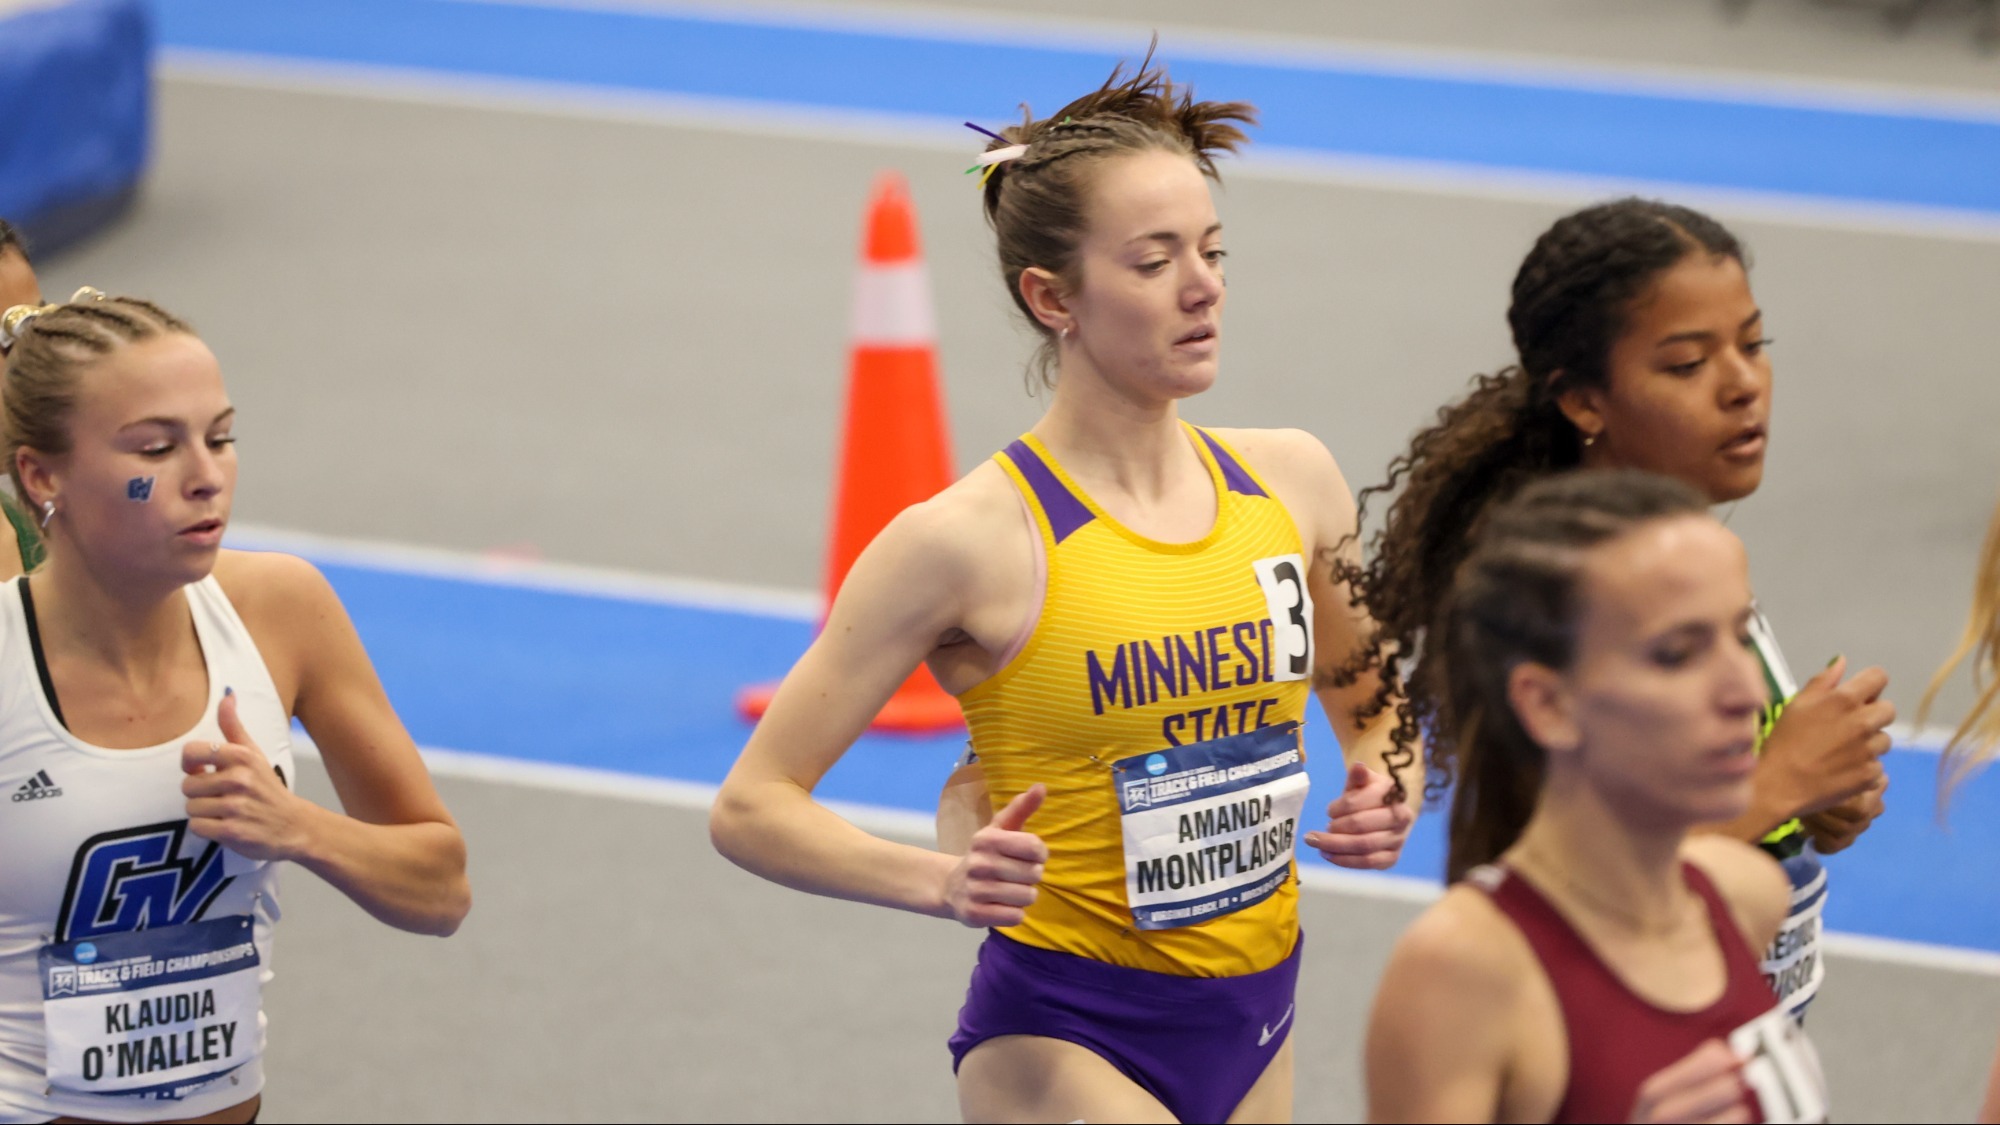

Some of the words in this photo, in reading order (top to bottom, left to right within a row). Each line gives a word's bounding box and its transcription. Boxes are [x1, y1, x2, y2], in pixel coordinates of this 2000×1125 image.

[1272, 561, 1309, 675] 3
[1086, 618, 1275, 716] MINNESO
[11, 787, 63, 803] adidas
[1151, 780, 1188, 798] TRACK
[1178, 794, 1273, 843] AMANDA
[1137, 817, 1295, 894] MONTPLAISIR
[78, 970, 120, 986] TRACK
[131, 961, 165, 980] FIELD
[105, 988, 217, 1034] KLAUDIA
